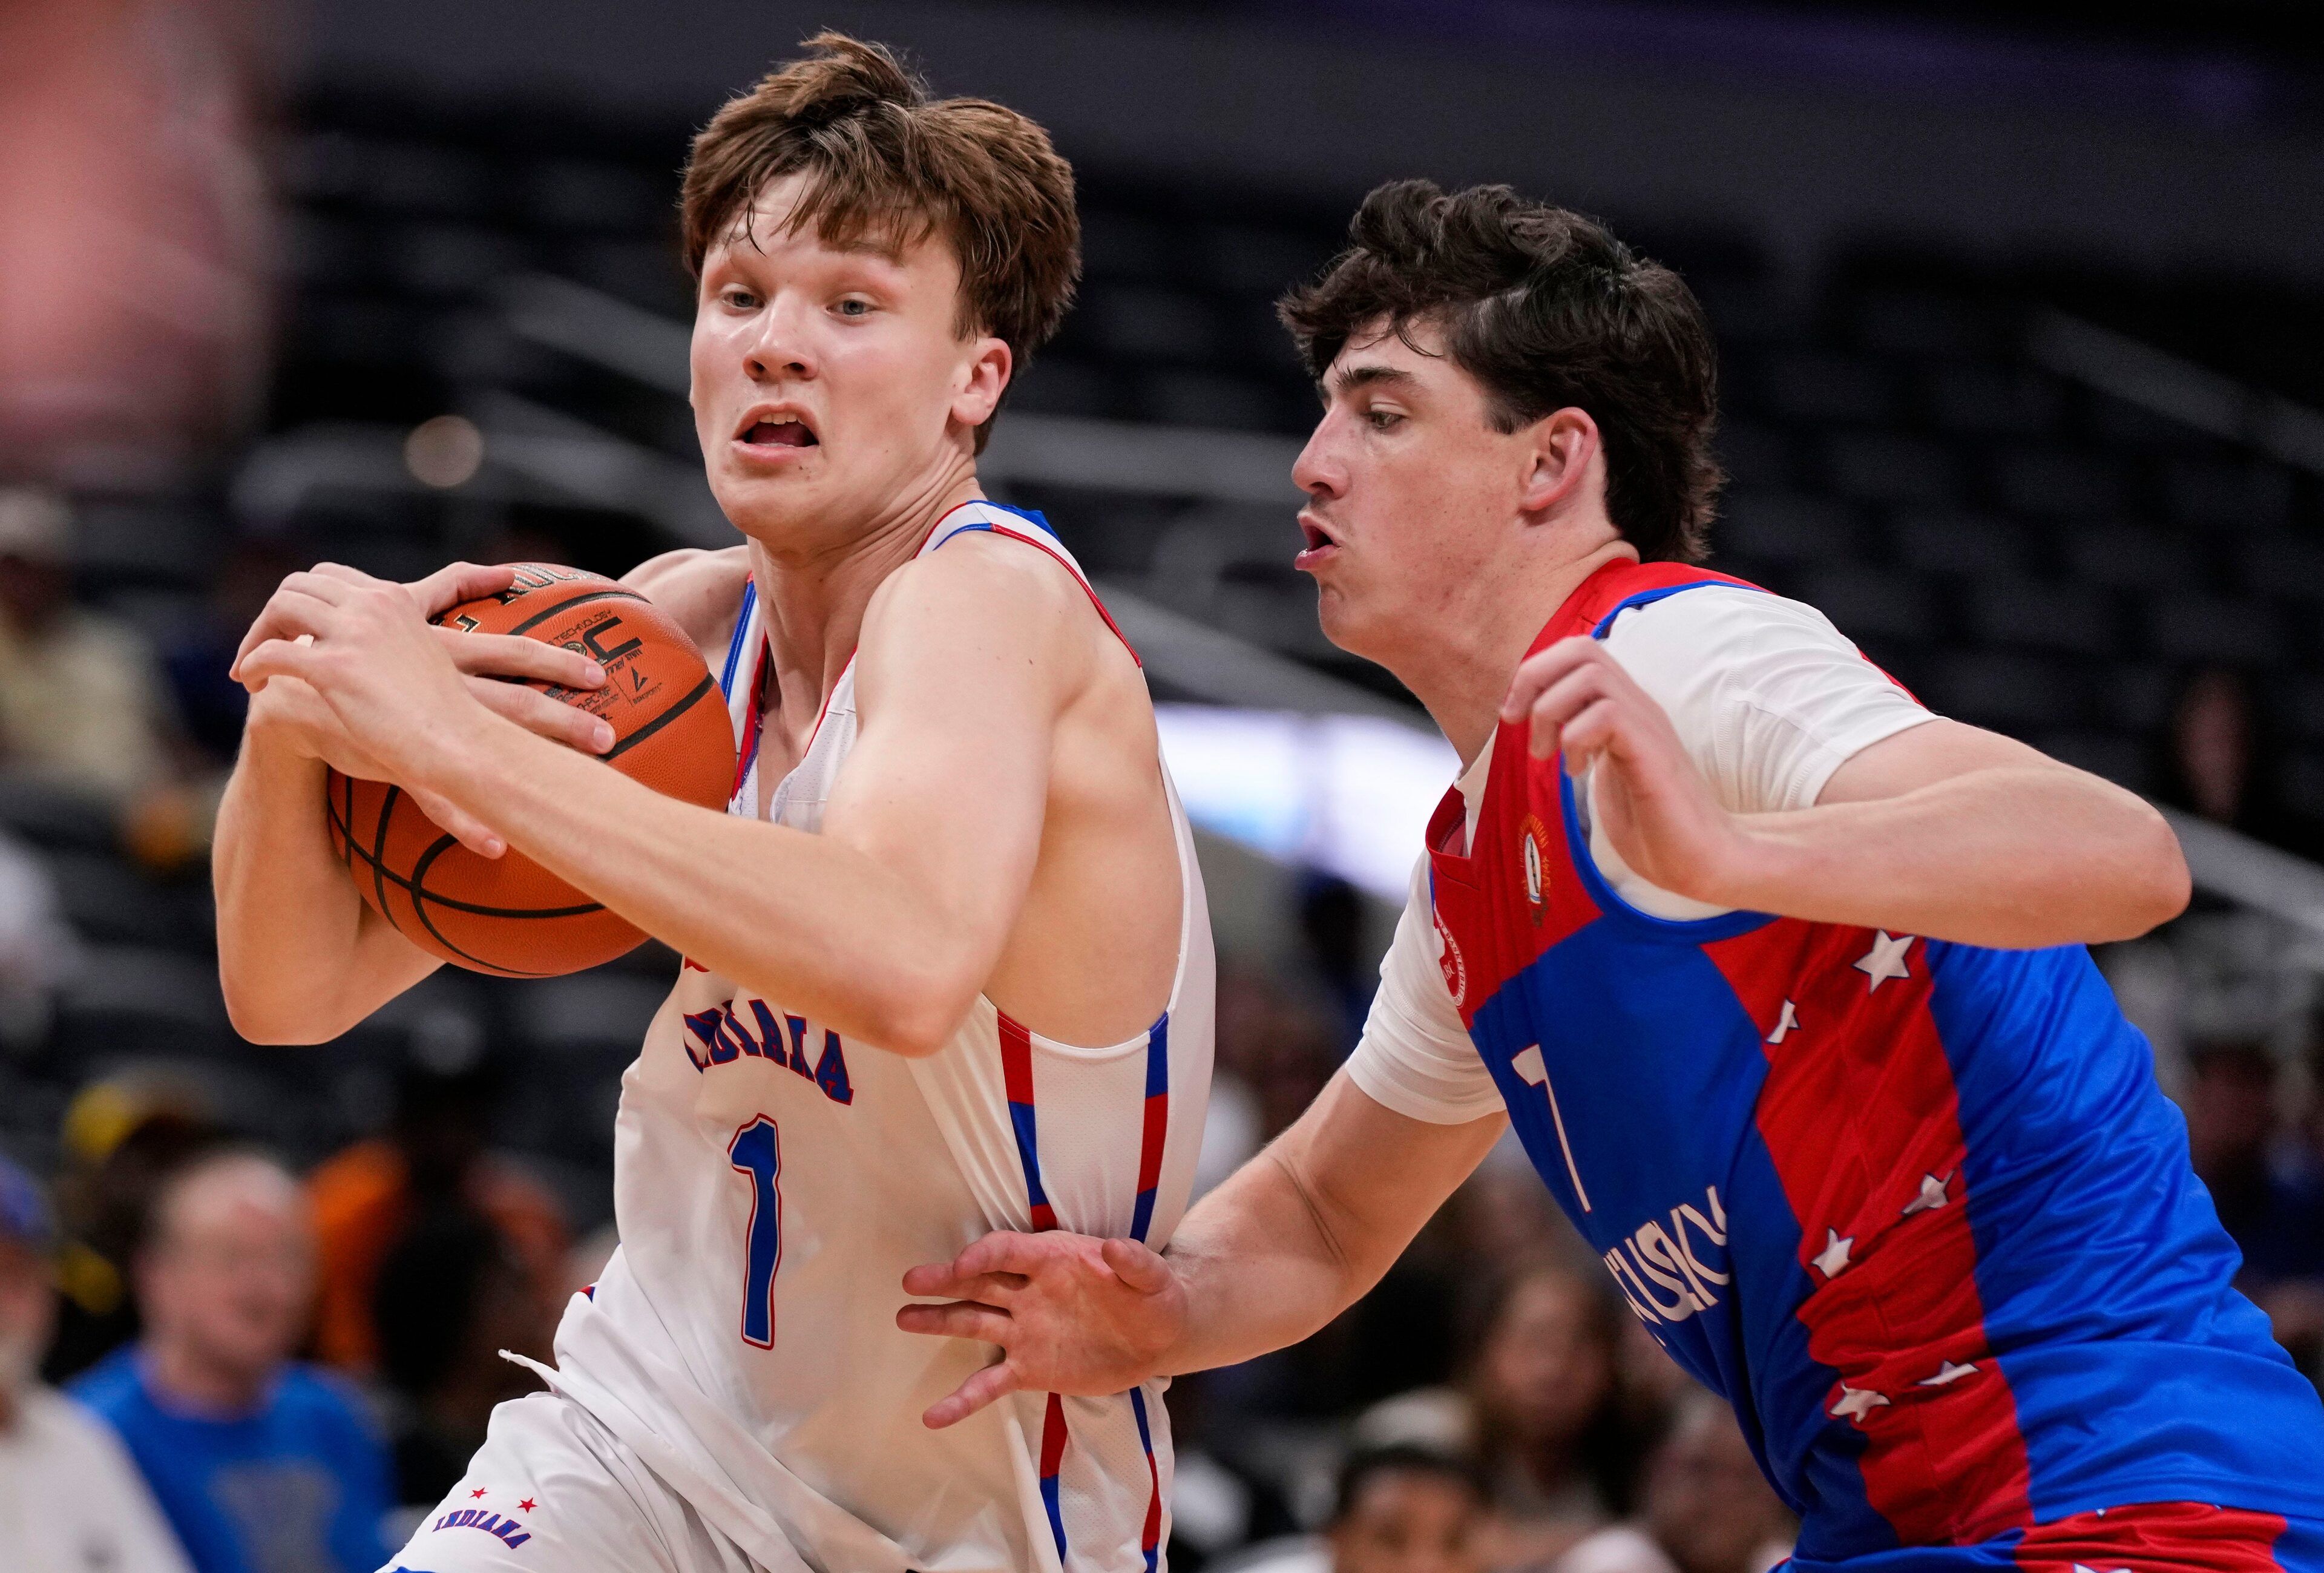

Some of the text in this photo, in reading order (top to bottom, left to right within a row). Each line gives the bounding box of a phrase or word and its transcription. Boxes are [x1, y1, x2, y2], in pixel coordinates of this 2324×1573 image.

[683, 998, 855, 1106] NDIANA
[1511, 1043, 1592, 1213] 7
[727, 1112, 783, 1351] 1
[432, 1509, 532, 1550] INDIANA
